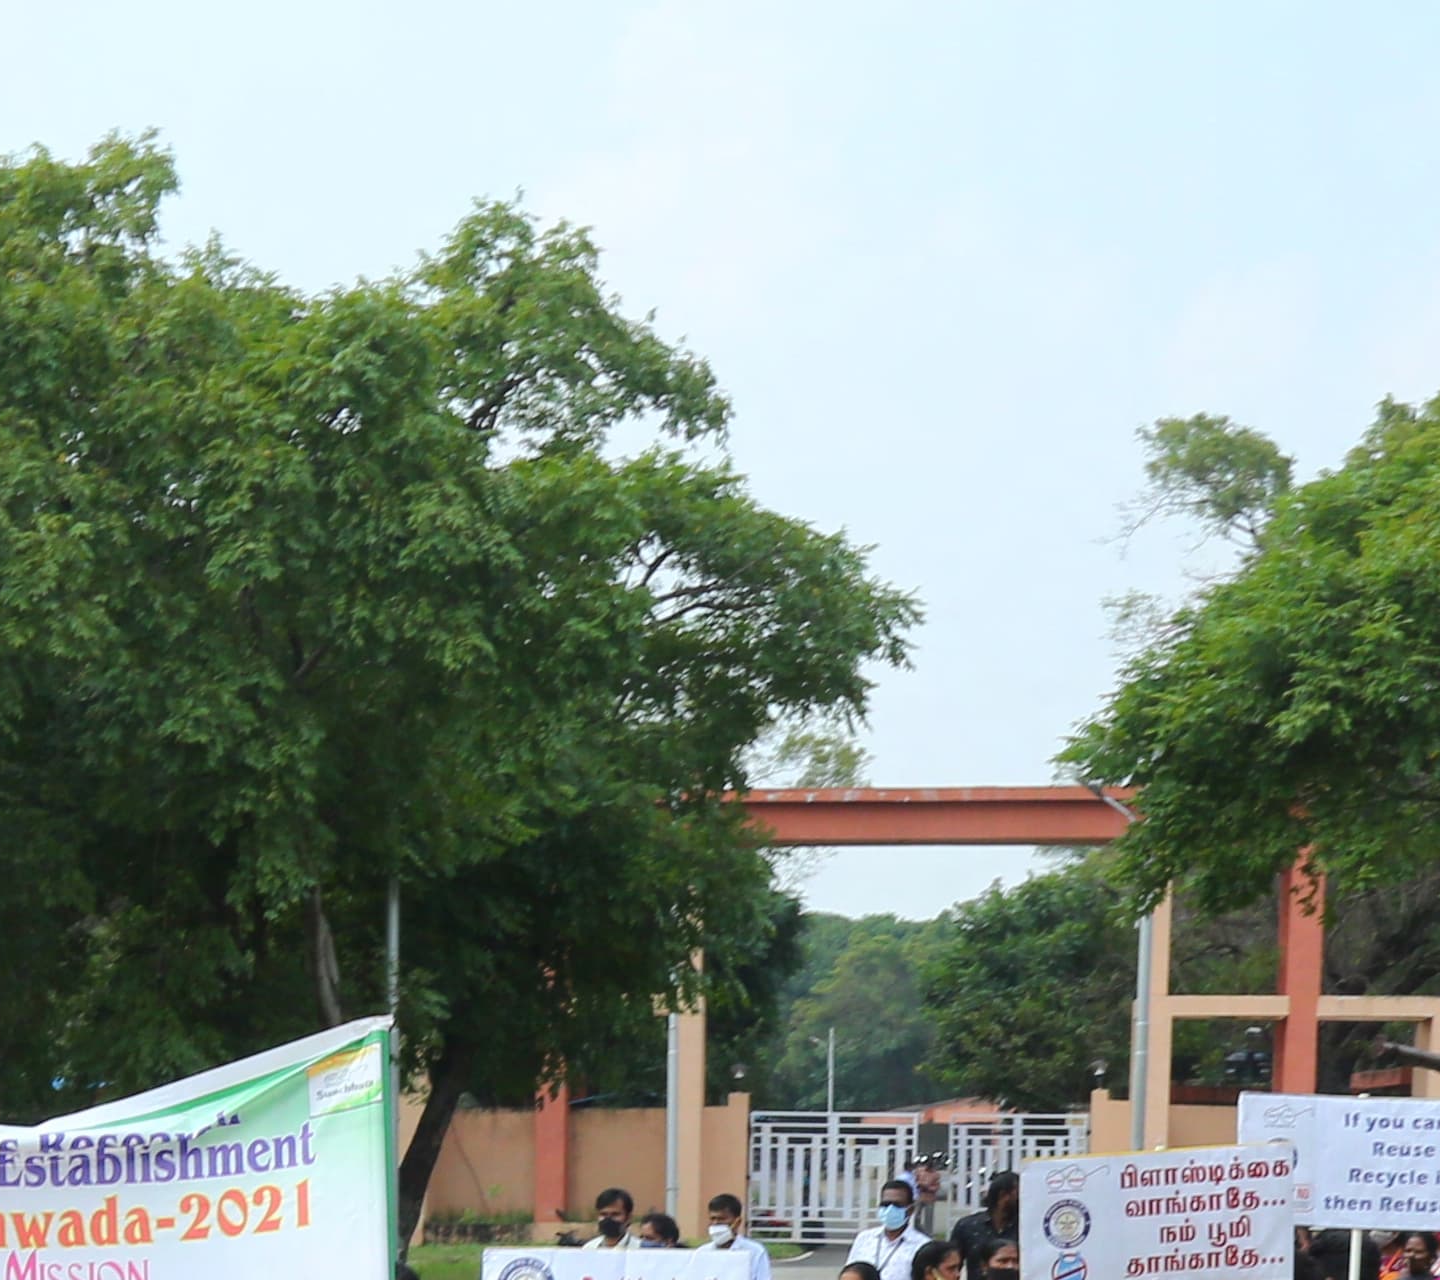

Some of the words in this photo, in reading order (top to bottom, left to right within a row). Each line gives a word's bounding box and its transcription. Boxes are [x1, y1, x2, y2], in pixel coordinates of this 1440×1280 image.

[1343, 1112, 1361, 1128] If
[1366, 1117, 1405, 1133] you
[1372, 1141, 1436, 1158] Reuse
[1120, 1155, 1290, 1189] பிளாஸ்டிக்கை
[1348, 1167, 1429, 1189] Recycle
[1125, 1186, 1286, 1218] வாங்காதே...
[1324, 1195, 1372, 1211] then
[1159, 1217, 1197, 1245] நம்
[1208, 1214, 1252, 1247] பூமி
[1123, 1244, 1285, 1279] தாங்காதே...
